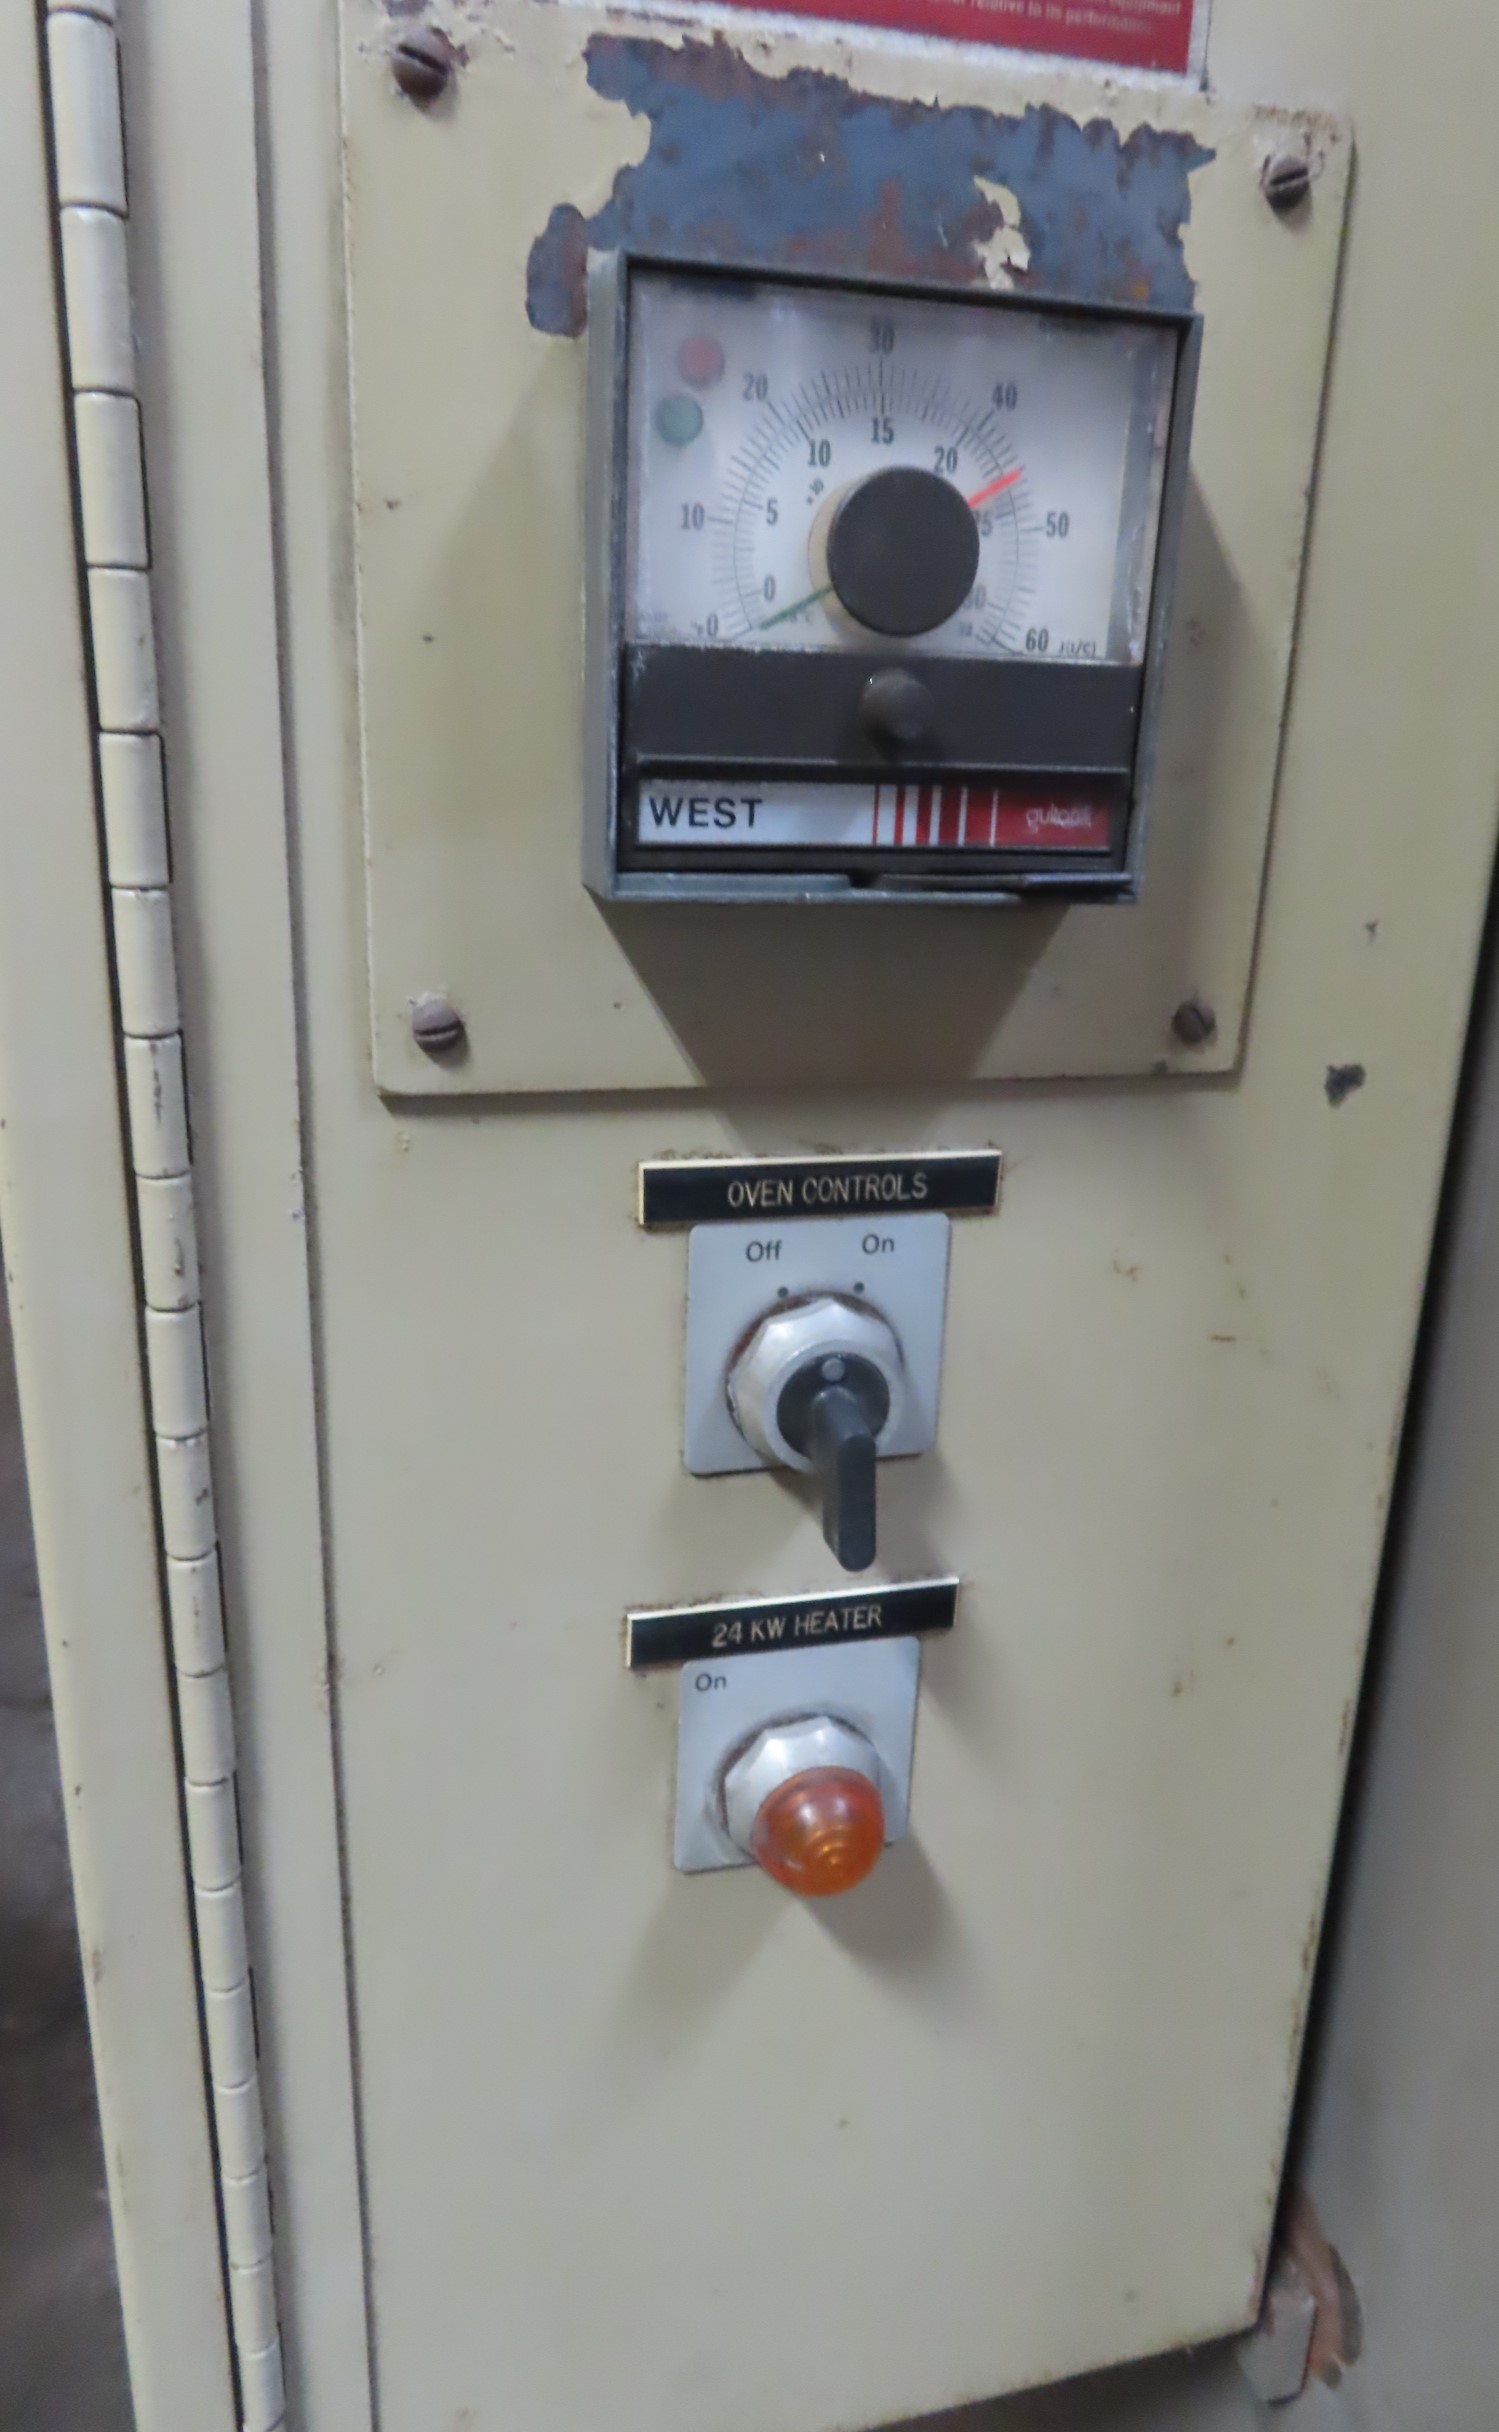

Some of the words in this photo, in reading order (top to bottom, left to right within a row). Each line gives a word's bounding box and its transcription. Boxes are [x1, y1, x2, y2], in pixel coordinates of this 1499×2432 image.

[869, 322, 895, 353] 30
[743, 374, 768, 400] 20
[993, 384, 1018, 410] 40
[872, 419, 895, 444] 15
[808, 440, 831, 467] 10
[934, 447, 958, 473] 20
[681, 505, 705, 531] 10
[766, 500, 778, 525] 5
[1046, 511, 1069, 538] 50
[763, 574, 776, 602] 0
[706, 613, 719, 638] 0
[1025, 628, 1049, 652] 60
[648, 798, 763, 829] WEST
[727, 1180, 793, 1208] OVEN
[802, 1173, 928, 1203] CONTROLS
[745, 1240, 782, 1262] Off
[862, 1234, 895, 1255] On
[713, 1622, 743, 1648] 24
[751, 1617, 786, 1642] KW
[795, 1605, 883, 1635] HEATER
[695, 1673, 727, 1692] On
